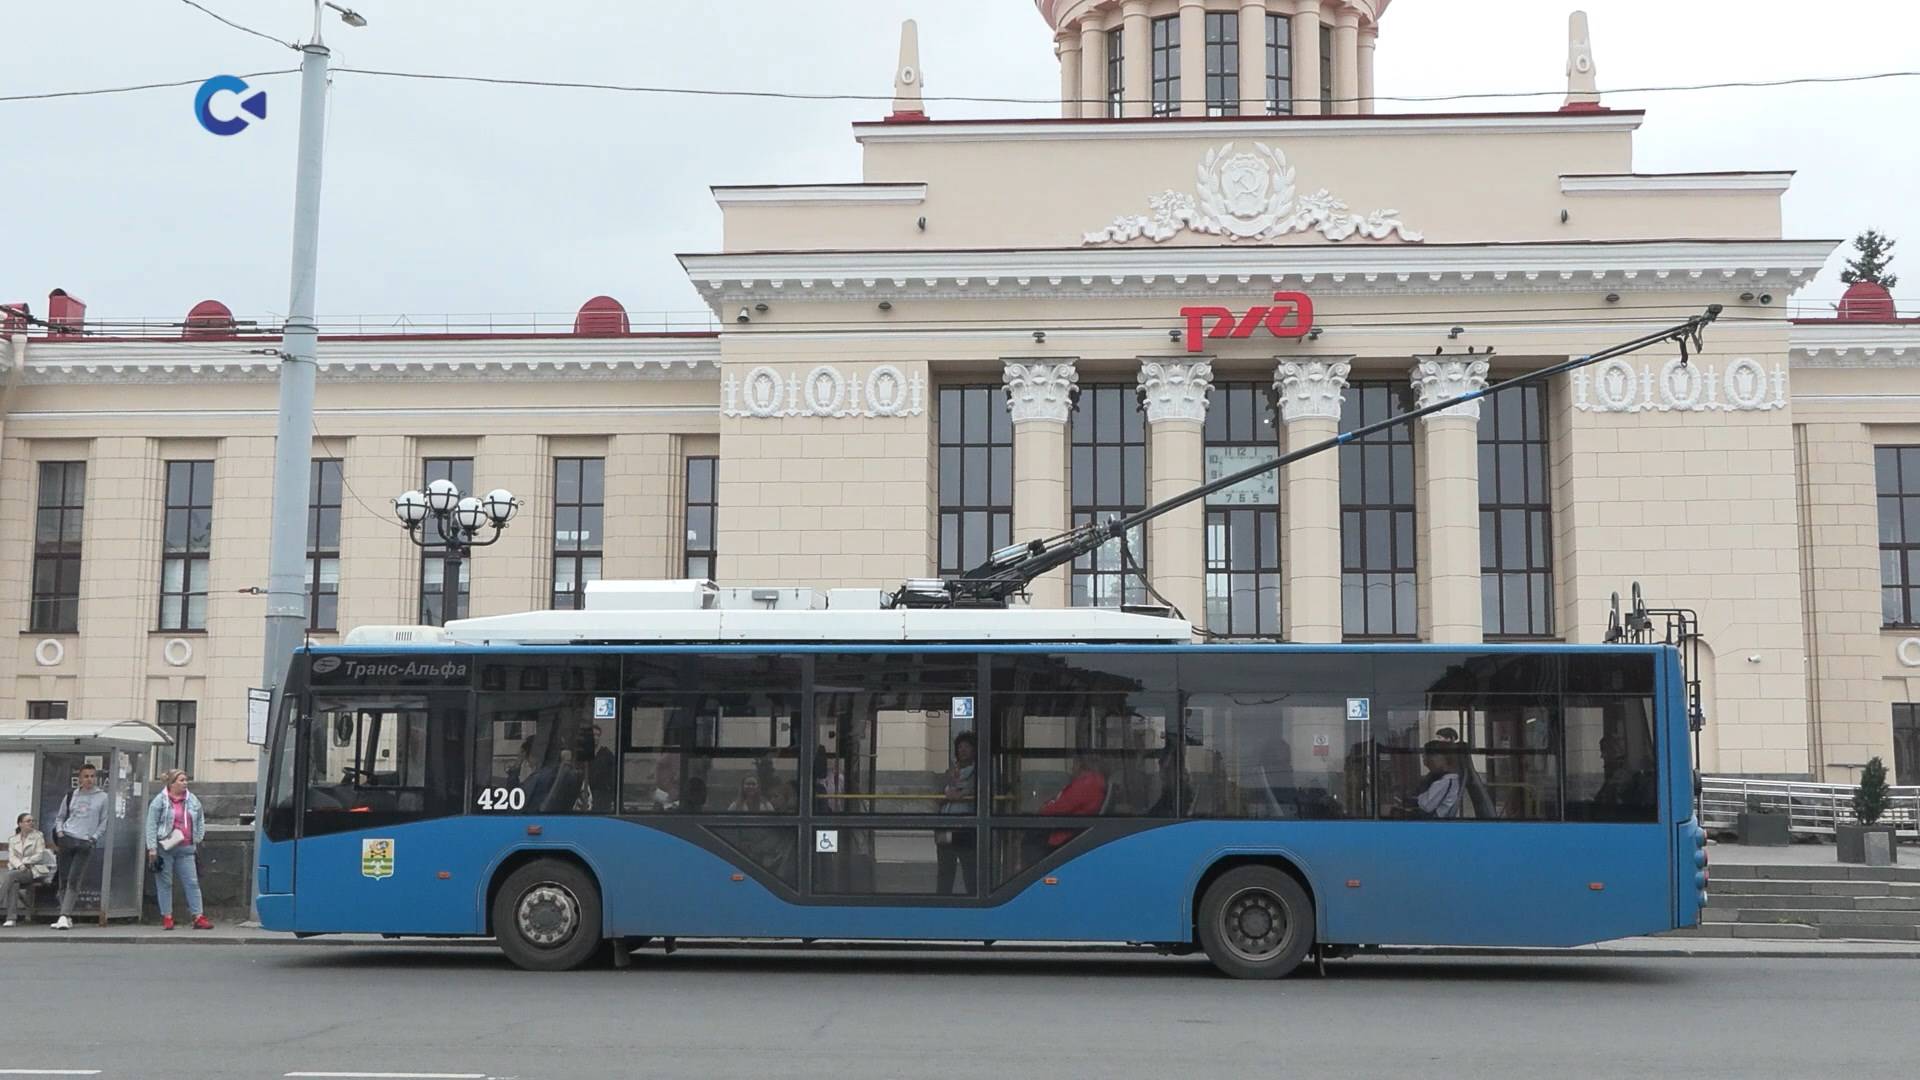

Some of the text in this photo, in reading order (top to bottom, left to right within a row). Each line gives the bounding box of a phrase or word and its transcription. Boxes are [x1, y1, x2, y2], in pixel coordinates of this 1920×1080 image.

[1237, 447, 1247, 456] 12
[1209, 454, 1218, 464] 10
[1267, 485, 1274, 495] 4
[1225, 494, 1260, 503] 7 6 5
[345, 661, 467, 679] Транс-Альфа
[477, 787, 526, 810] 420
